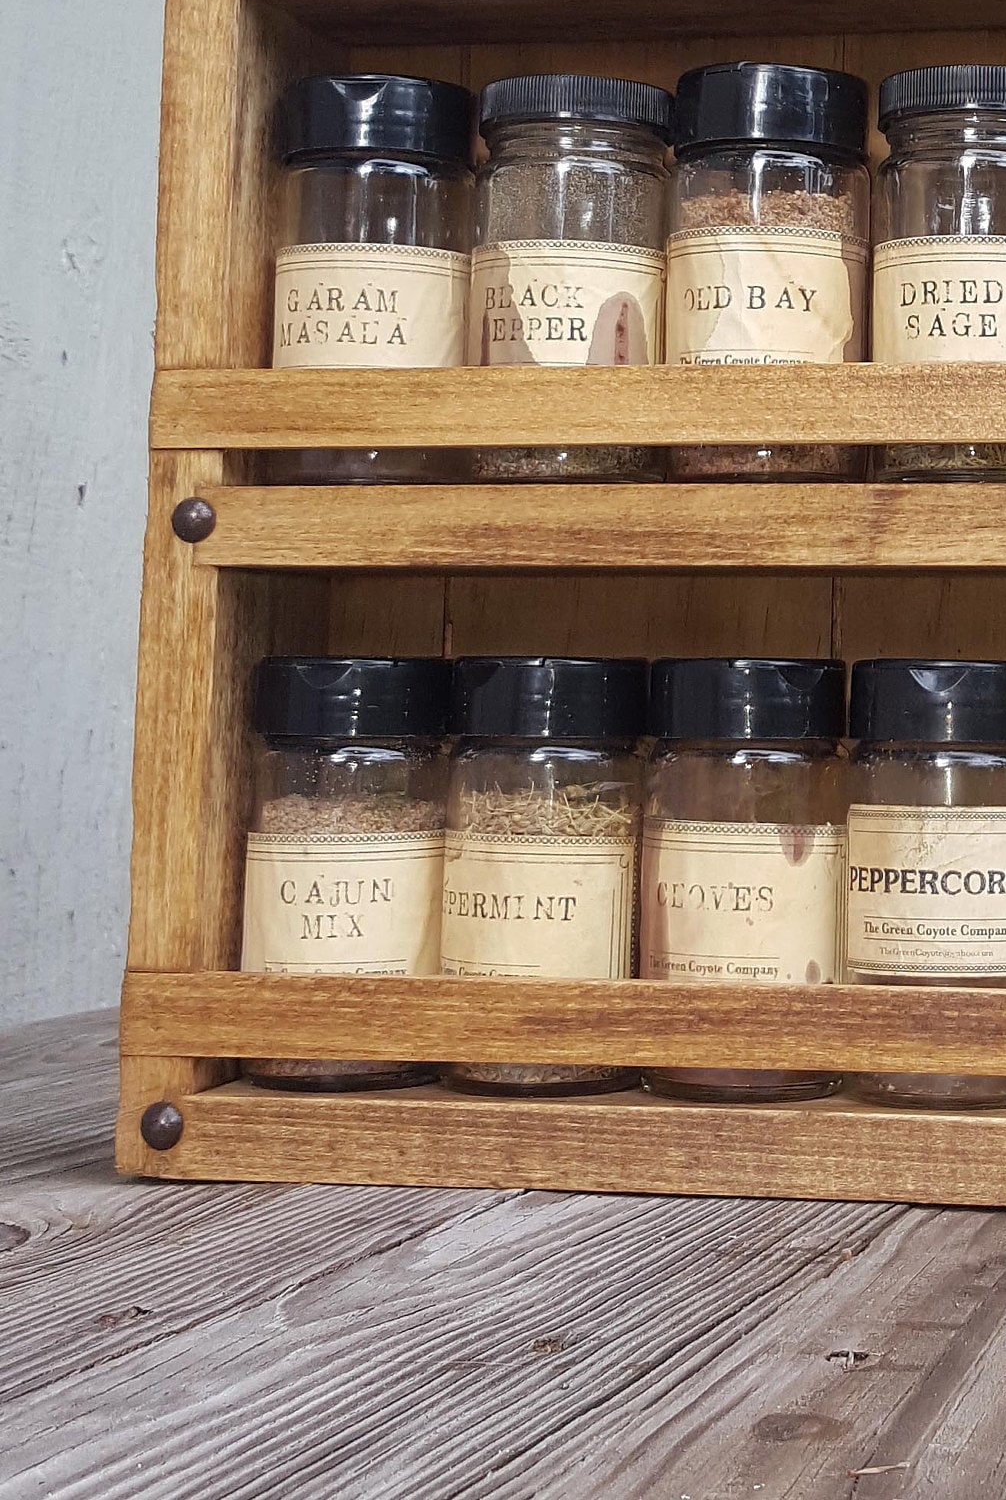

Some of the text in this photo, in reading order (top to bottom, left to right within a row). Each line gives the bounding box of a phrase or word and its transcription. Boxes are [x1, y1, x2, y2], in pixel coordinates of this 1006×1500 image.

[287, 282, 399, 313] GARAM
[485, 278, 585, 310] BLACK
[684, 281, 818, 312] OLD BAY
[900, 280, 1004, 307] DRIED
[280, 315, 408, 348] MASALA
[484, 317, 588, 343] EPPER
[905, 308, 998, 340] SAGE
[280, 874, 393, 907] CAJUN
[444, 889, 577, 921] PERMINT
[656, 880, 774, 912] CLOVES
[300, 912, 365, 940] MIX
[863, 920, 880, 934] The
[882, 922, 914, 935] Green
[916, 923, 958, 939] Coyote
[661, 957, 687, 972] Green
[688, 959, 723, 975] Coyote
[726, 961, 780, 978] Company
